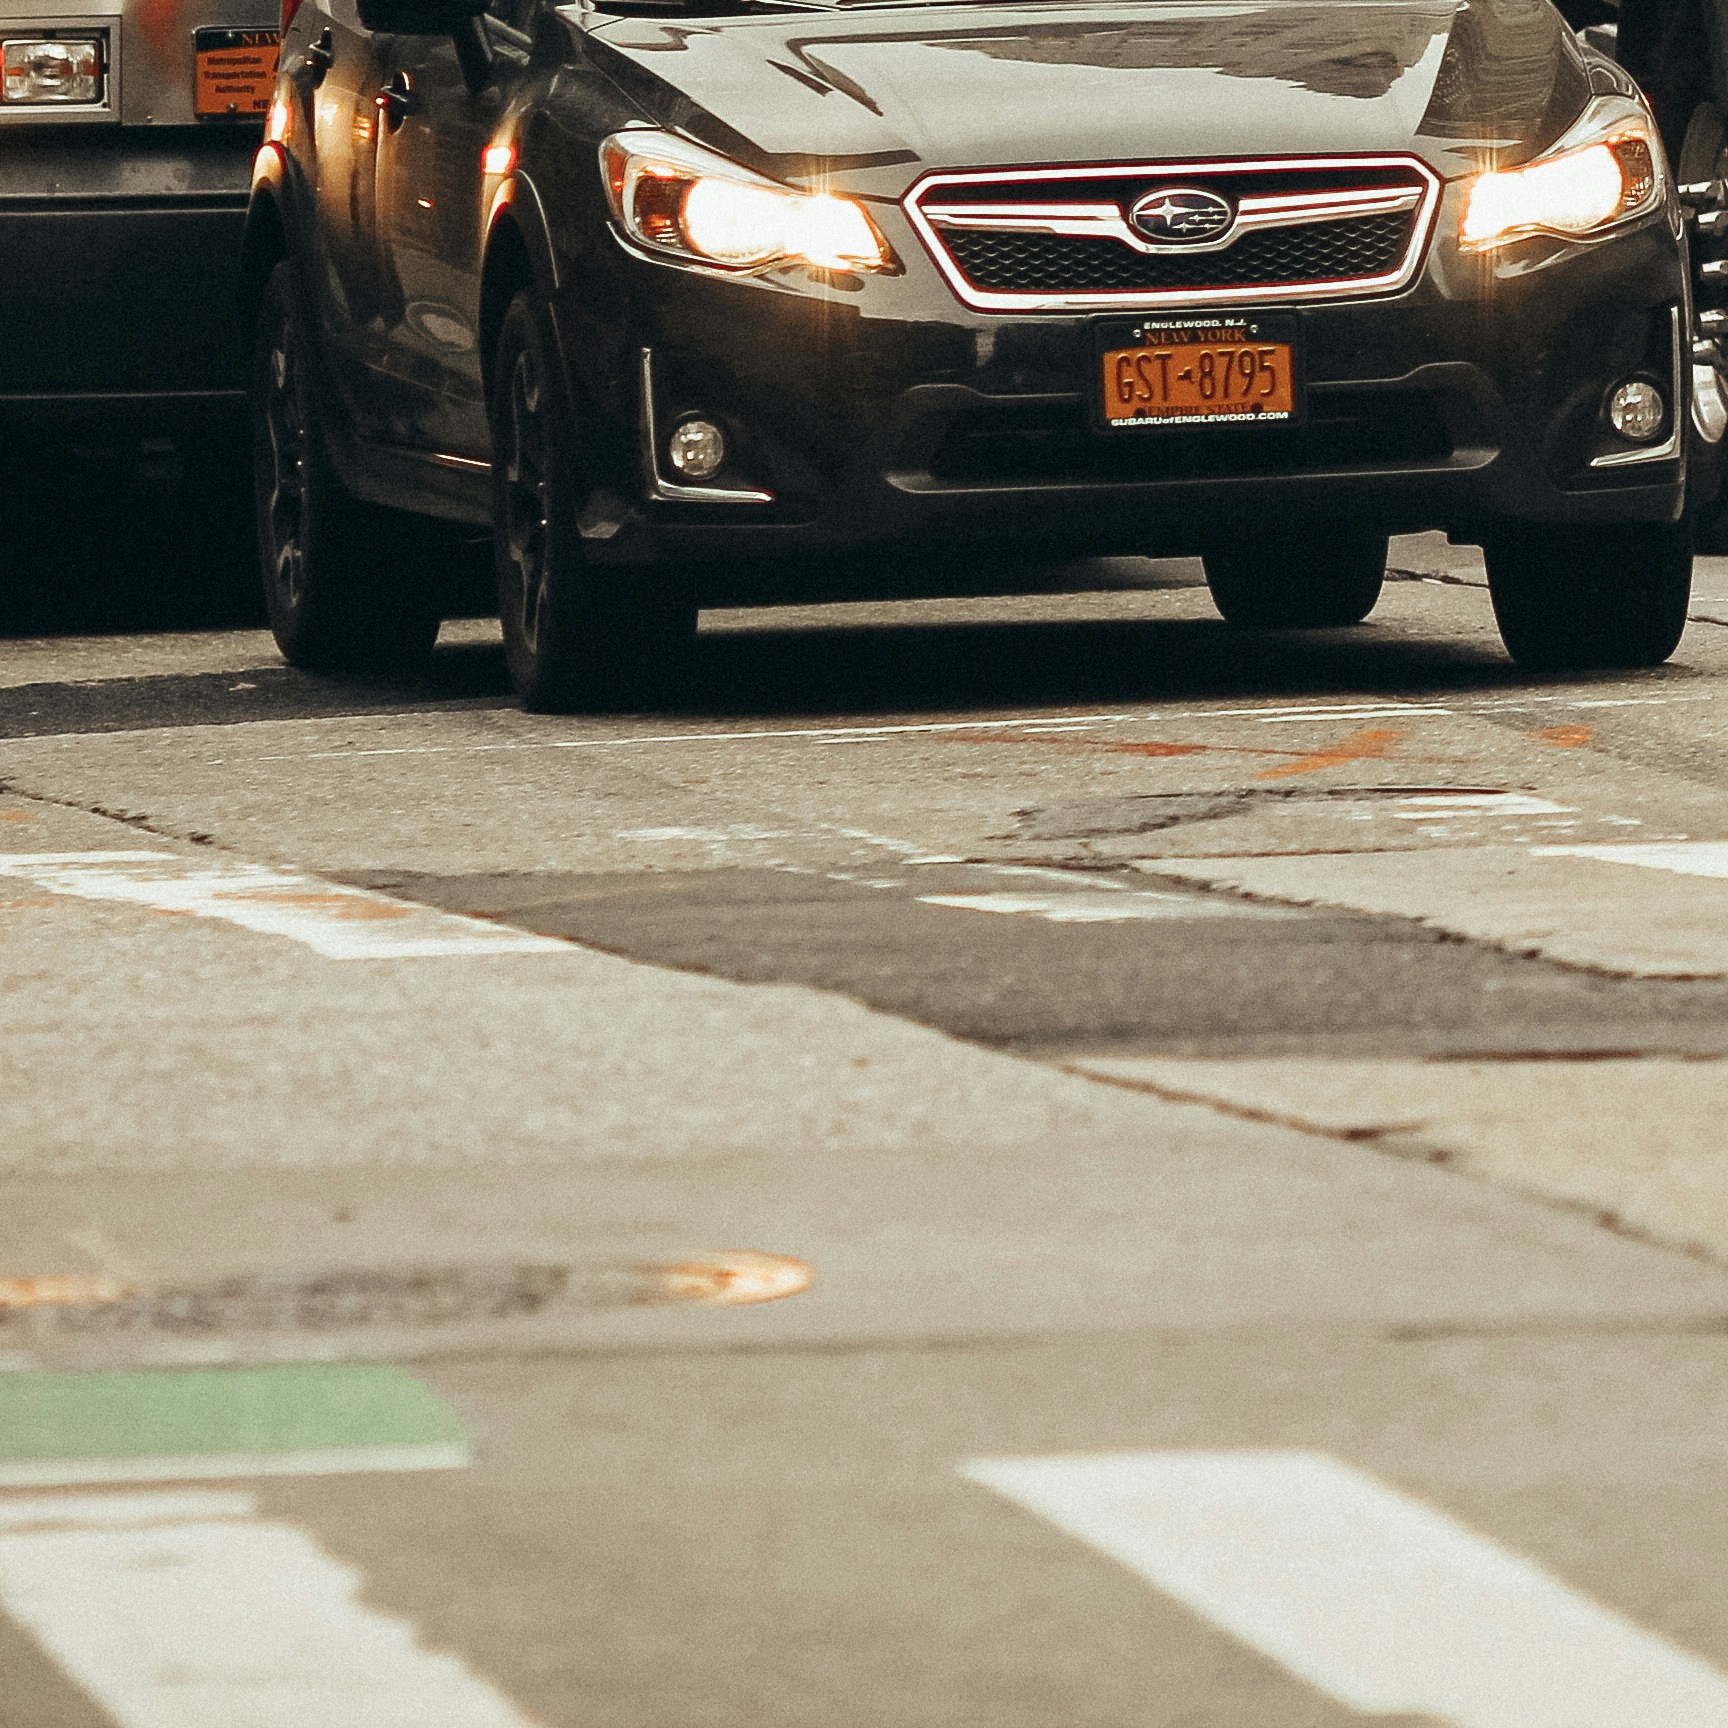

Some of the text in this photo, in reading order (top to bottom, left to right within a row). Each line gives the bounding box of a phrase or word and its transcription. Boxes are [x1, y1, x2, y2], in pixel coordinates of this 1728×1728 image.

[1145, 328, 1247, 346] NEW YORK
[1205, 403, 1250, 414] STATE
